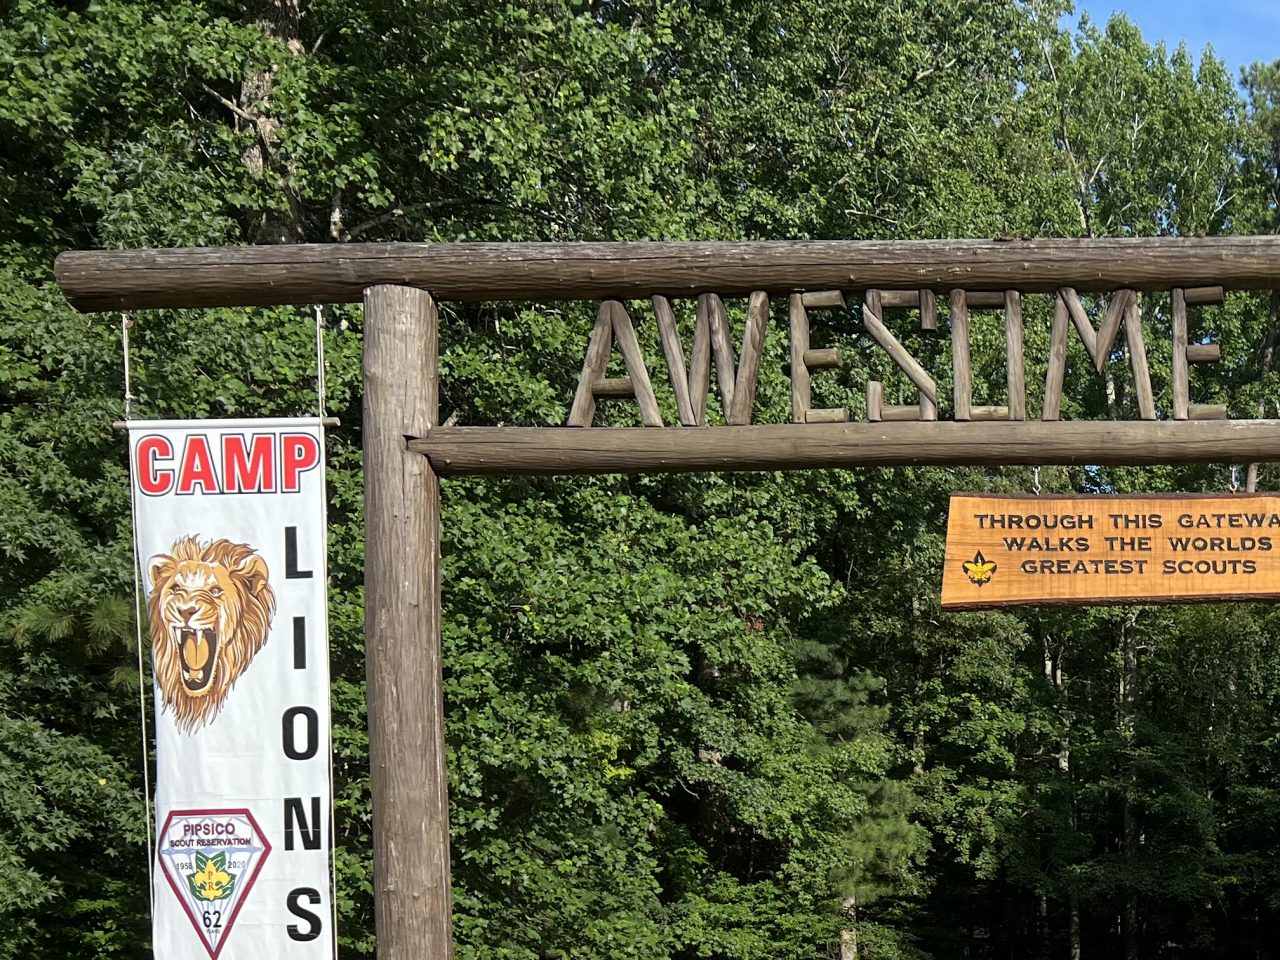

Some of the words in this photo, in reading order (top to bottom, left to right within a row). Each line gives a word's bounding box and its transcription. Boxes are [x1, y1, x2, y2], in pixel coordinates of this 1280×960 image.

[567, 286, 1228, 428] AWESOME
[136, 432, 320, 496] CAMP
[973, 513, 1094, 530] THROUGH
[1108, 513, 1163, 529] THIS
[1002, 536, 1091, 552] WALKS
[1103, 536, 1152, 551] THE
[1167, 536, 1273, 552] WORLDS
[1020, 558, 1149, 575] GREATEST
[1161, 558, 1257, 574] SCOUTS
[281, 526, 323, 942] LIONS
[183, 822, 236, 836] PIPSICO
[169, 839, 194, 848] SCOUT
[197, 838, 252, 847] RESERVATION
[202, 910, 222, 929] 62
